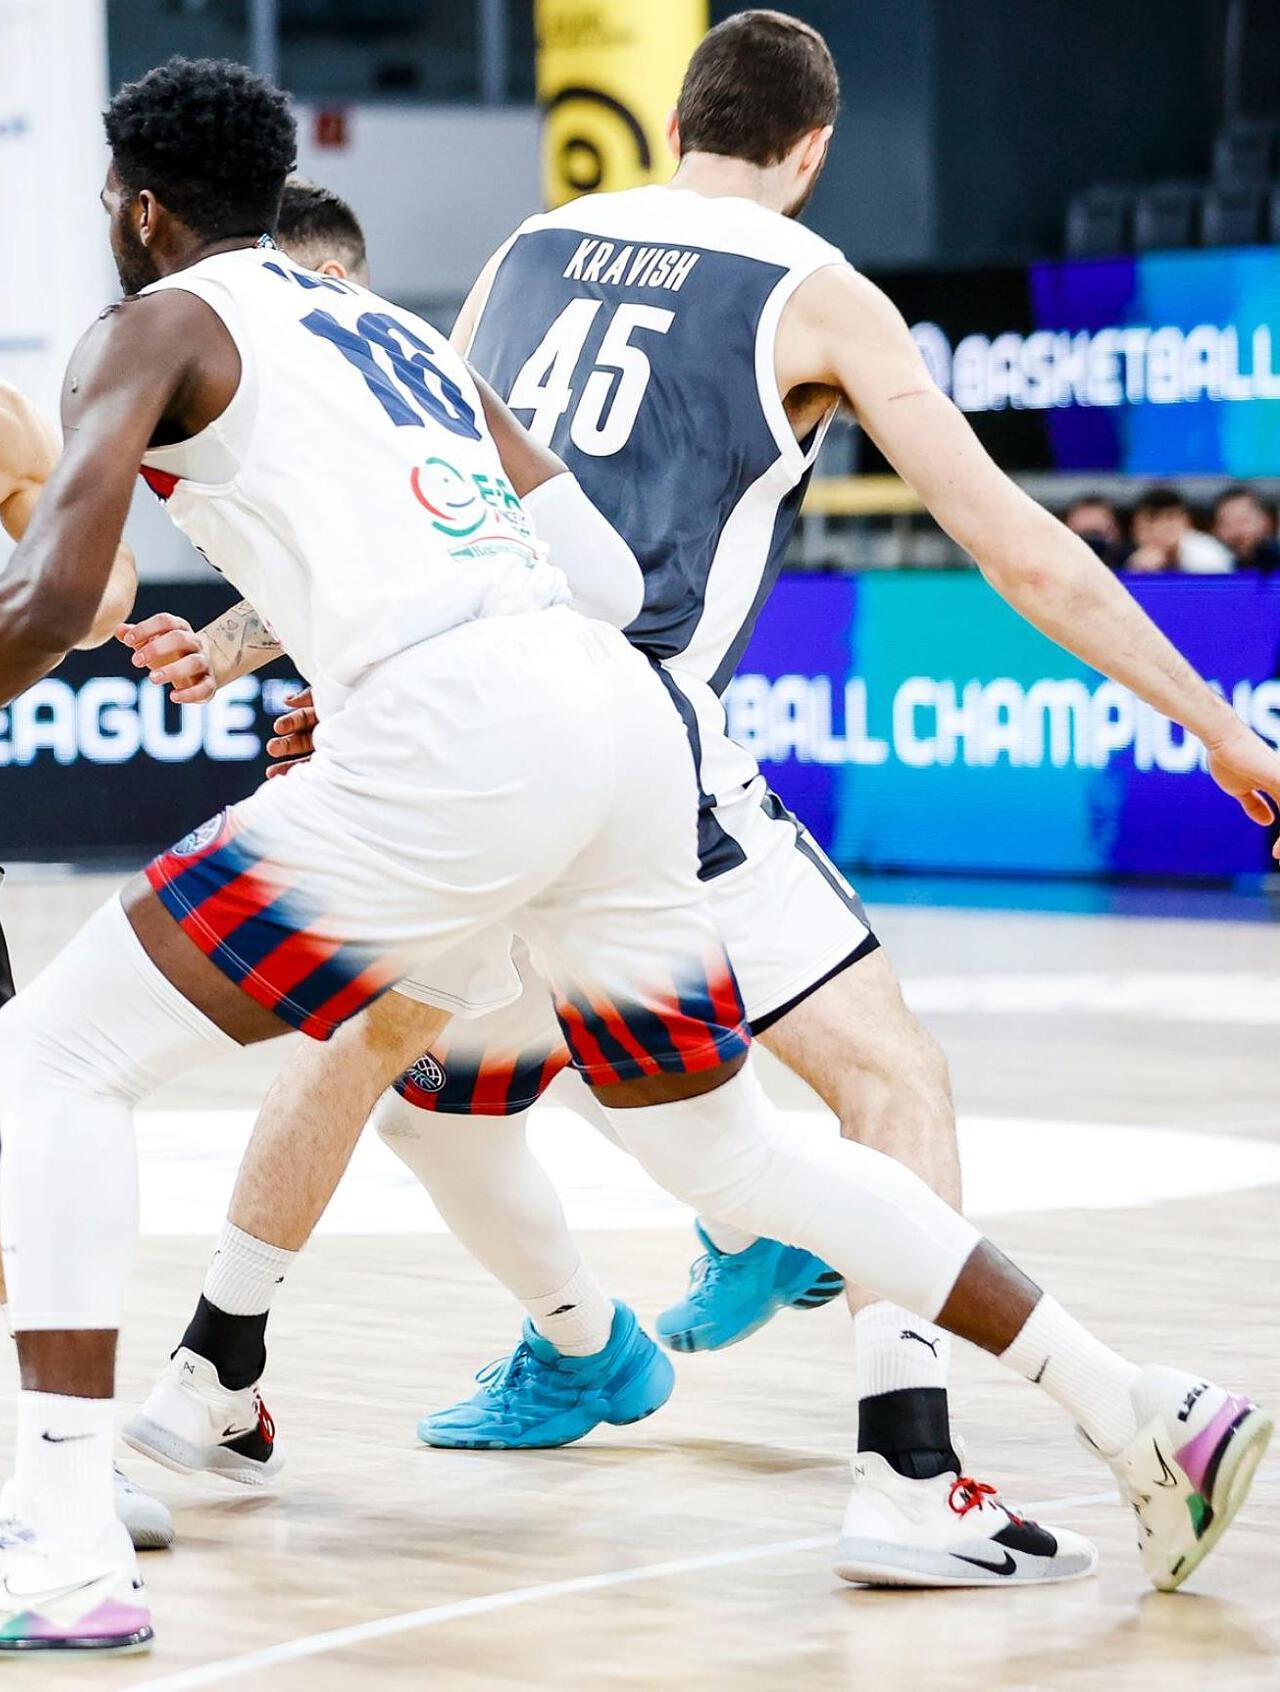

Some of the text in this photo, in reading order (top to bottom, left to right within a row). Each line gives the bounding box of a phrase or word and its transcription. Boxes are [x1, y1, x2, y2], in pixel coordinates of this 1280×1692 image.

[563, 238, 701, 292] KRAVISH
[299, 308, 483, 442] 16
[507, 297, 676, 458] 45
[952, 323, 1280, 413] BASKETBALL
